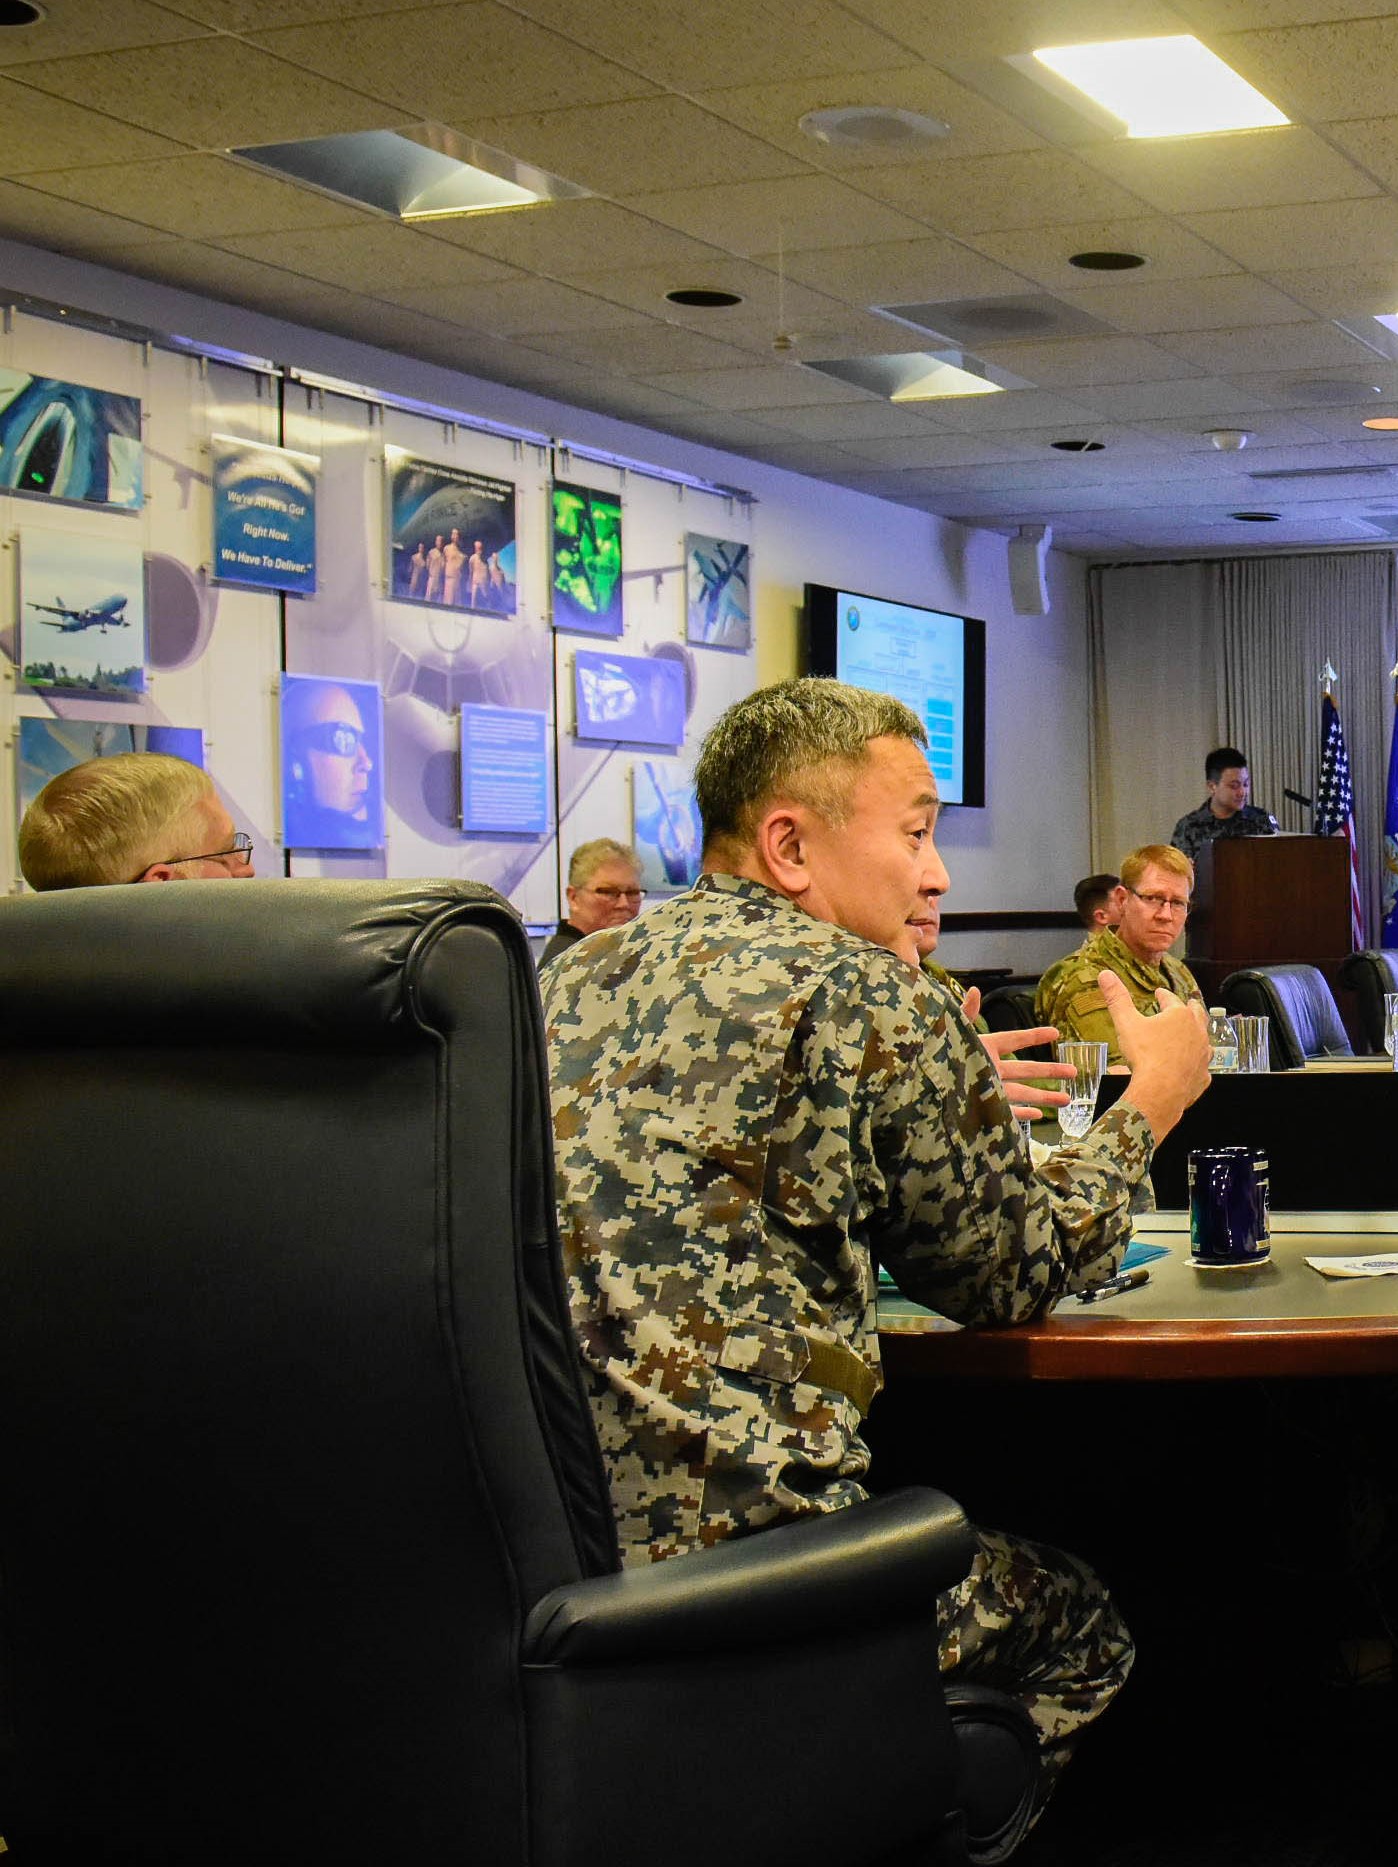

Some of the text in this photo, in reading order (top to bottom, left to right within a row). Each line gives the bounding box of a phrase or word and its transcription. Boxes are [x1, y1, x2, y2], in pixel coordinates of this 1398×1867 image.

[289, 503, 305, 516] Got
[243, 522, 289, 541] Right Now.
[221, 548, 236, 562] We
[237, 551, 260, 565] Have
[262, 555, 273, 567] To
